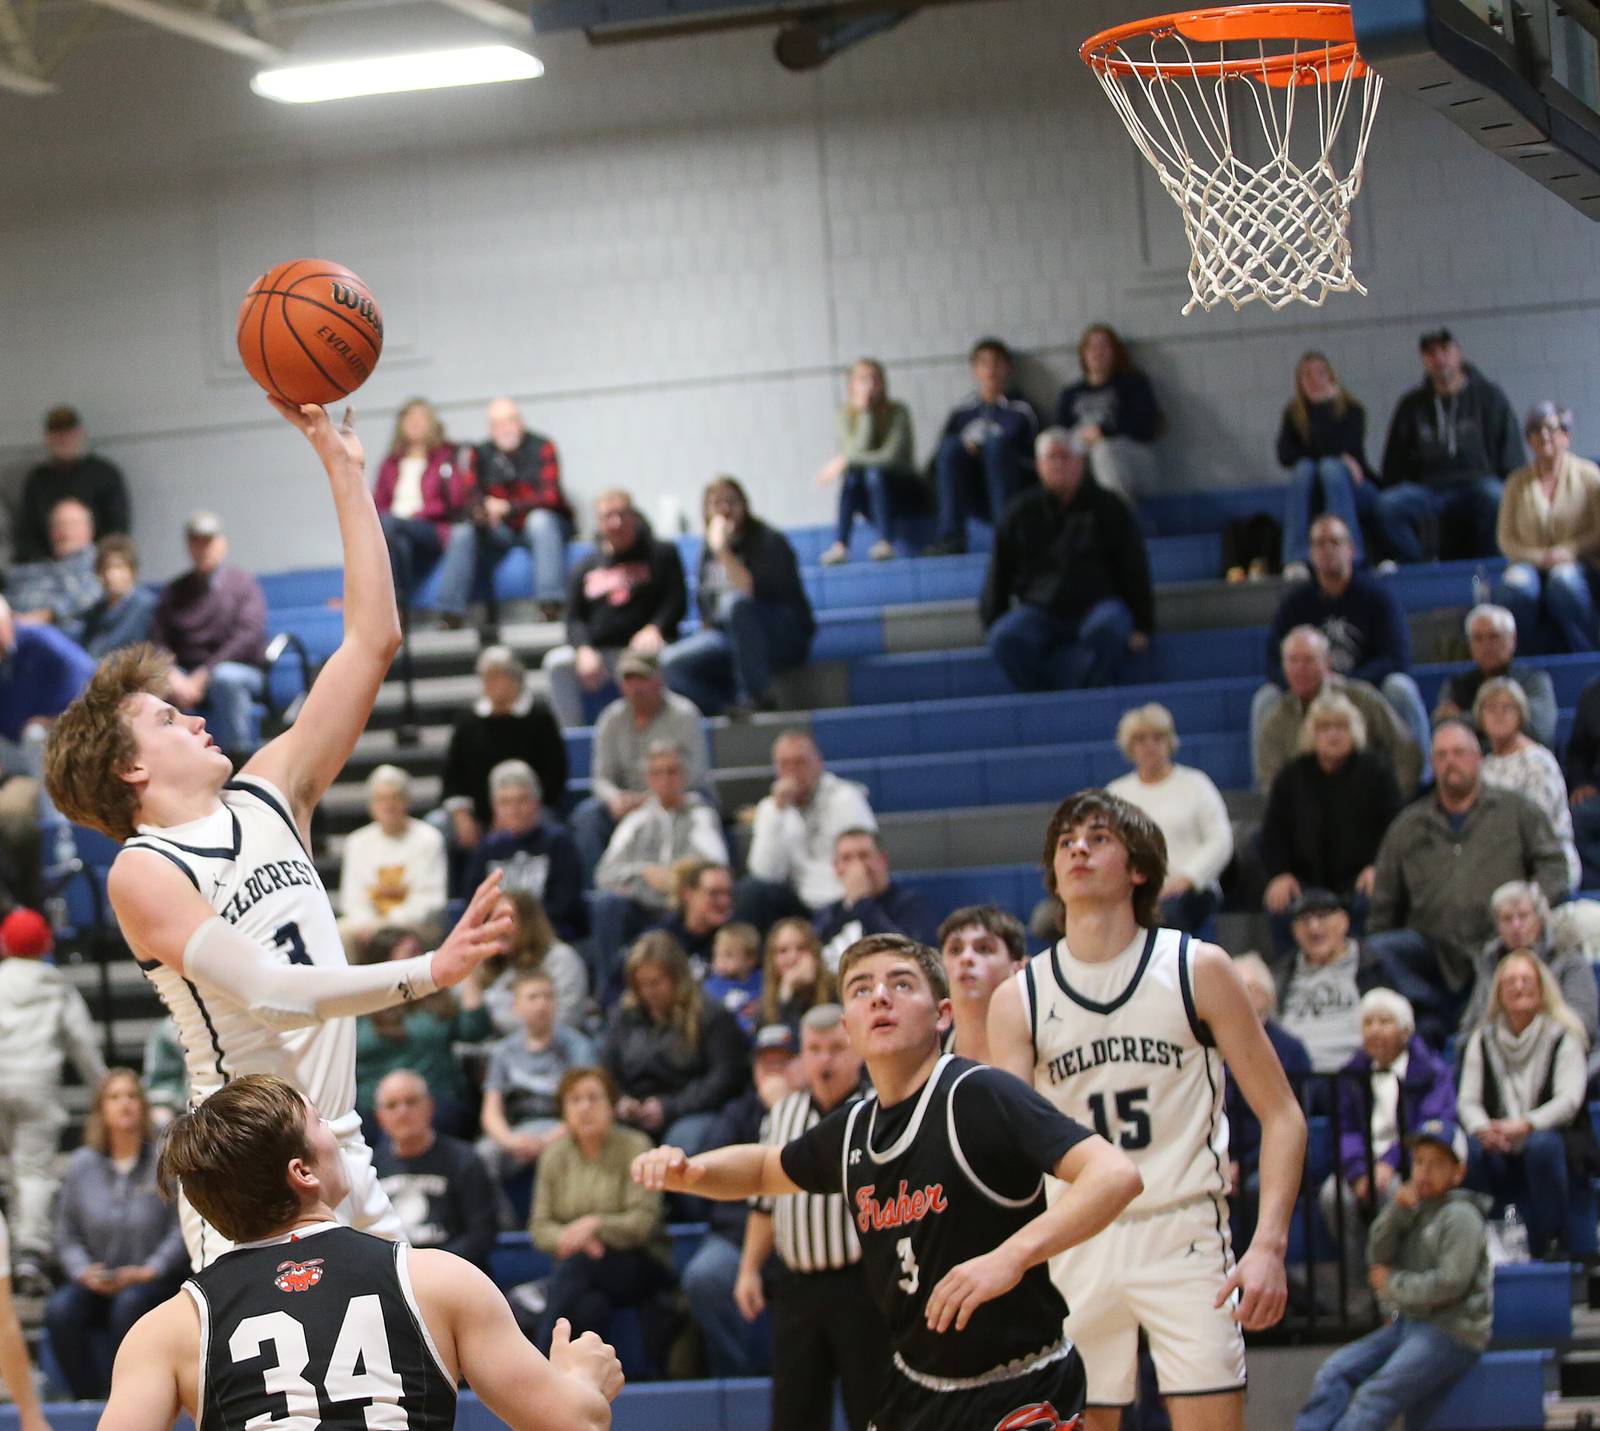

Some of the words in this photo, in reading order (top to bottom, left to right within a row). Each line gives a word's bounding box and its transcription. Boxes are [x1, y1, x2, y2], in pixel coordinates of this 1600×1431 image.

[1048, 1035, 1183, 1085] FIELDCREST
[1087, 1086, 1152, 1151] 15
[855, 1179, 948, 1233] Fisher
[896, 1236, 920, 1295] 3
[228, 1294, 409, 1431] 34
